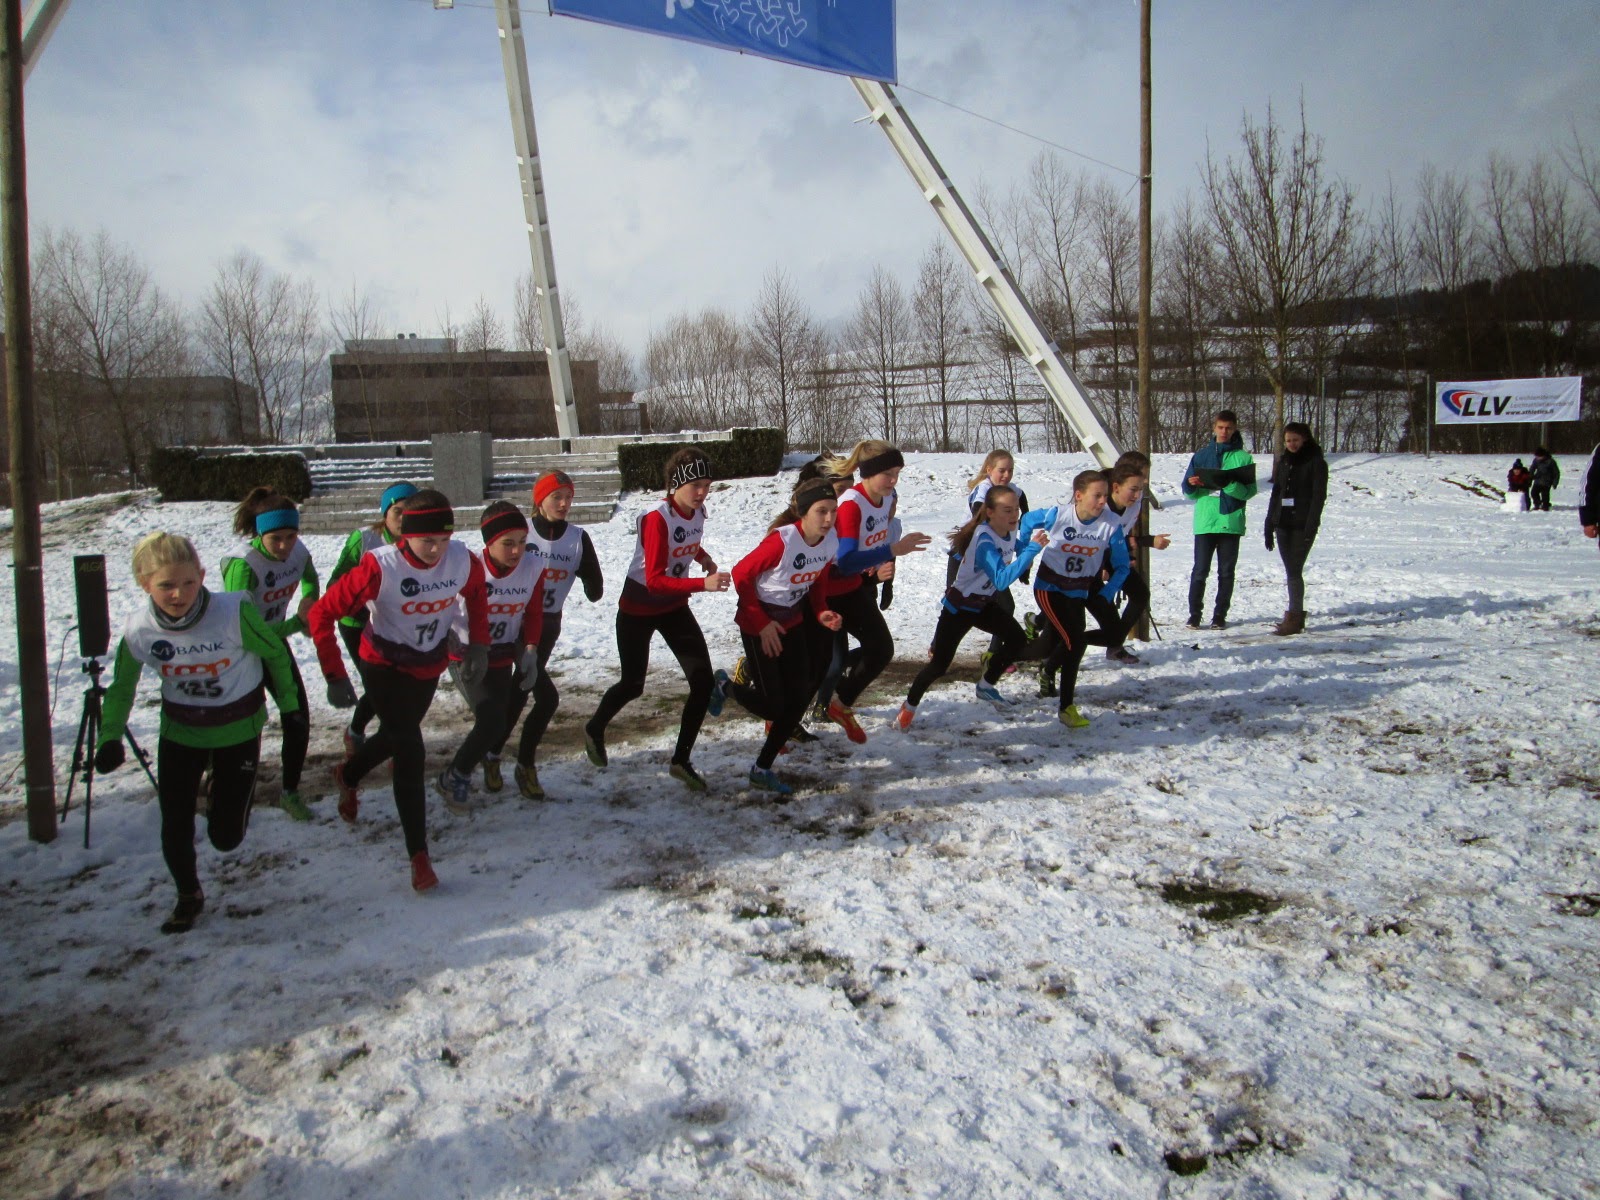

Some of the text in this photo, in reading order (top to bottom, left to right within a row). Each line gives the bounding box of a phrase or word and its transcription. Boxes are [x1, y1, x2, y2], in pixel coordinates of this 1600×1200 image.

[1461, 396, 1512, 416] LLV
[540, 551, 572, 562] BANK
[1061, 543, 1099, 557] coop
[1065, 556, 1085, 573] 65
[543, 567, 569, 583] op
[421, 579, 458, 592] BANK
[494, 587, 528, 596] BANK
[401, 596, 456, 615] coop
[488, 602, 525, 617] oop
[415, 619, 439, 647] 79
[176, 641, 225, 655] BANK
[161, 657, 231, 678] coop
